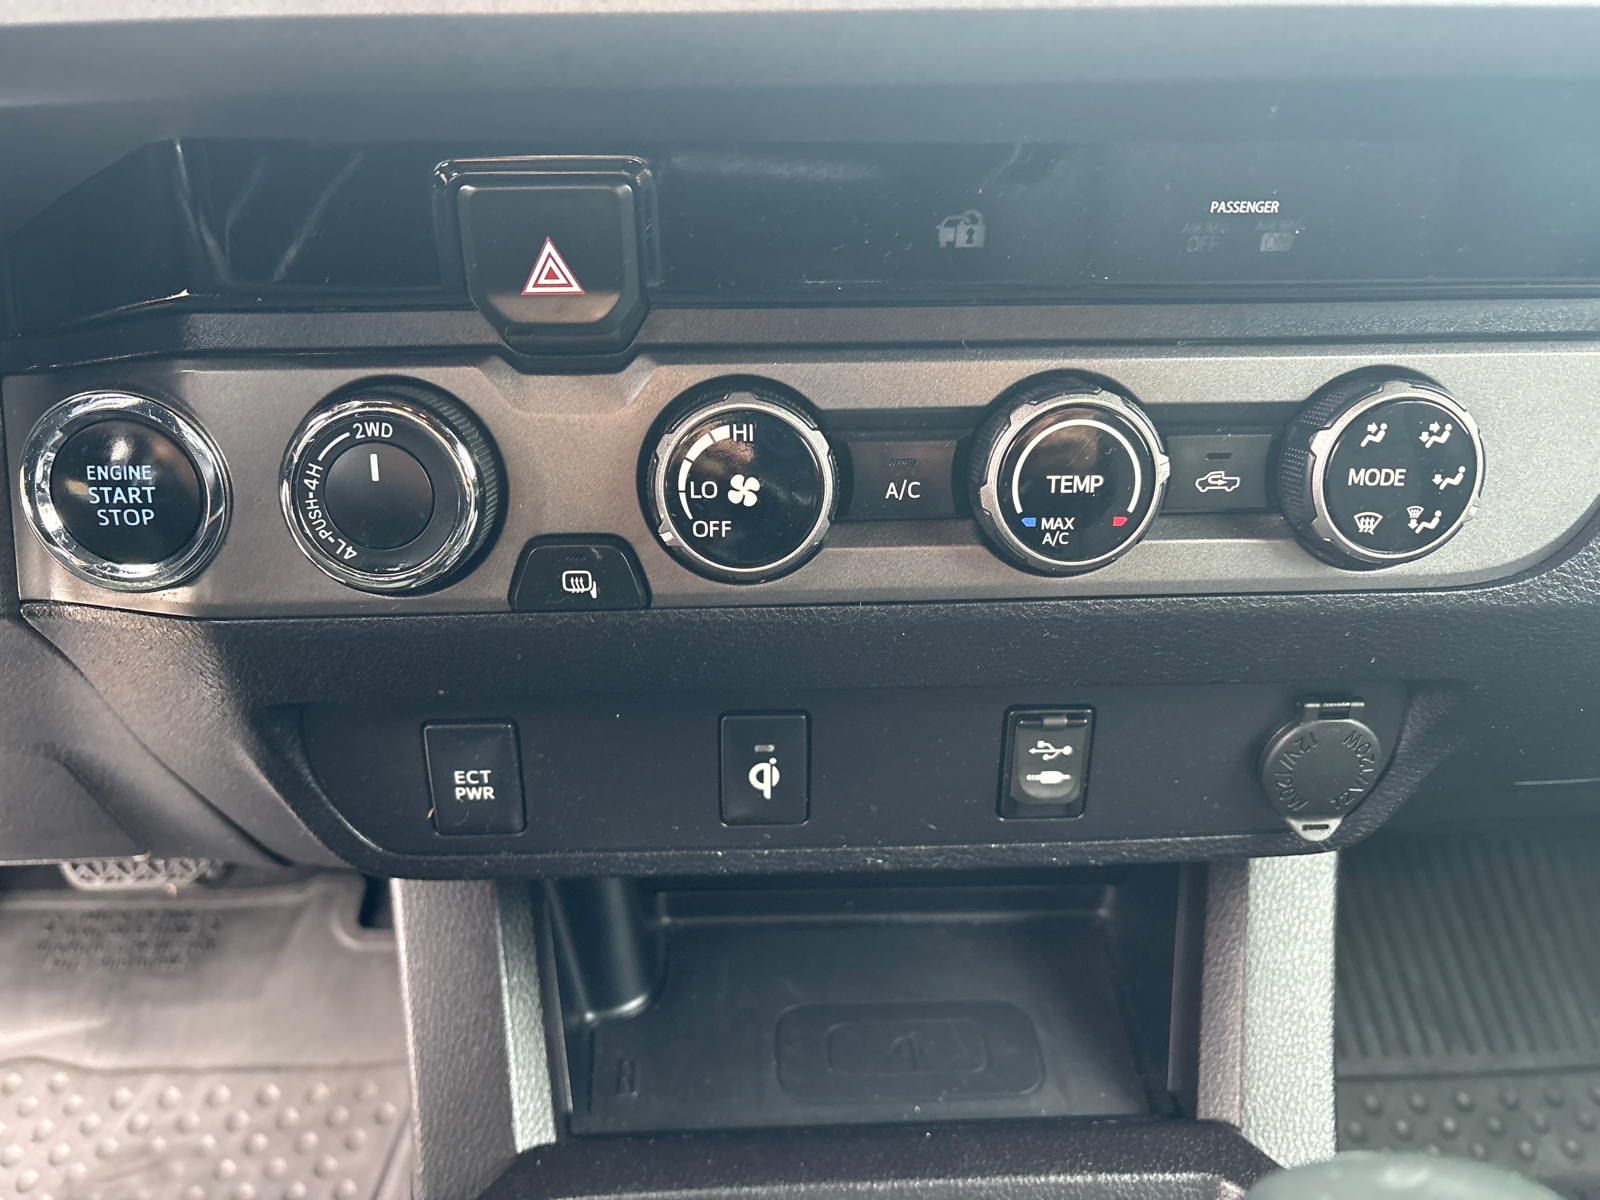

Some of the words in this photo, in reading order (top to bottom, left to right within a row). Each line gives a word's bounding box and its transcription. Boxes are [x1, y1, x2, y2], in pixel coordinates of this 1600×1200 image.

[1209, 200, 1280, 214] PASSENGER
[352, 421, 393, 440] 2WD
[732, 423, 754, 442] HI
[86, 465, 153, 481] ENGINE
[1347, 467, 1407, 487] MODE
[690, 481, 719, 499] LO
[885, 479, 921, 501] A/C
[1046, 475, 1105, 494] TEMP
[88, 486, 156, 504] START
[96, 508, 155, 526] STOP
[1041, 517, 1076, 531] MAX
[692, 520, 732, 538] OFF
[1041, 532, 1070, 547] A/C
[454, 769, 492, 785] ECT
[455, 785, 496, 801] PWR
